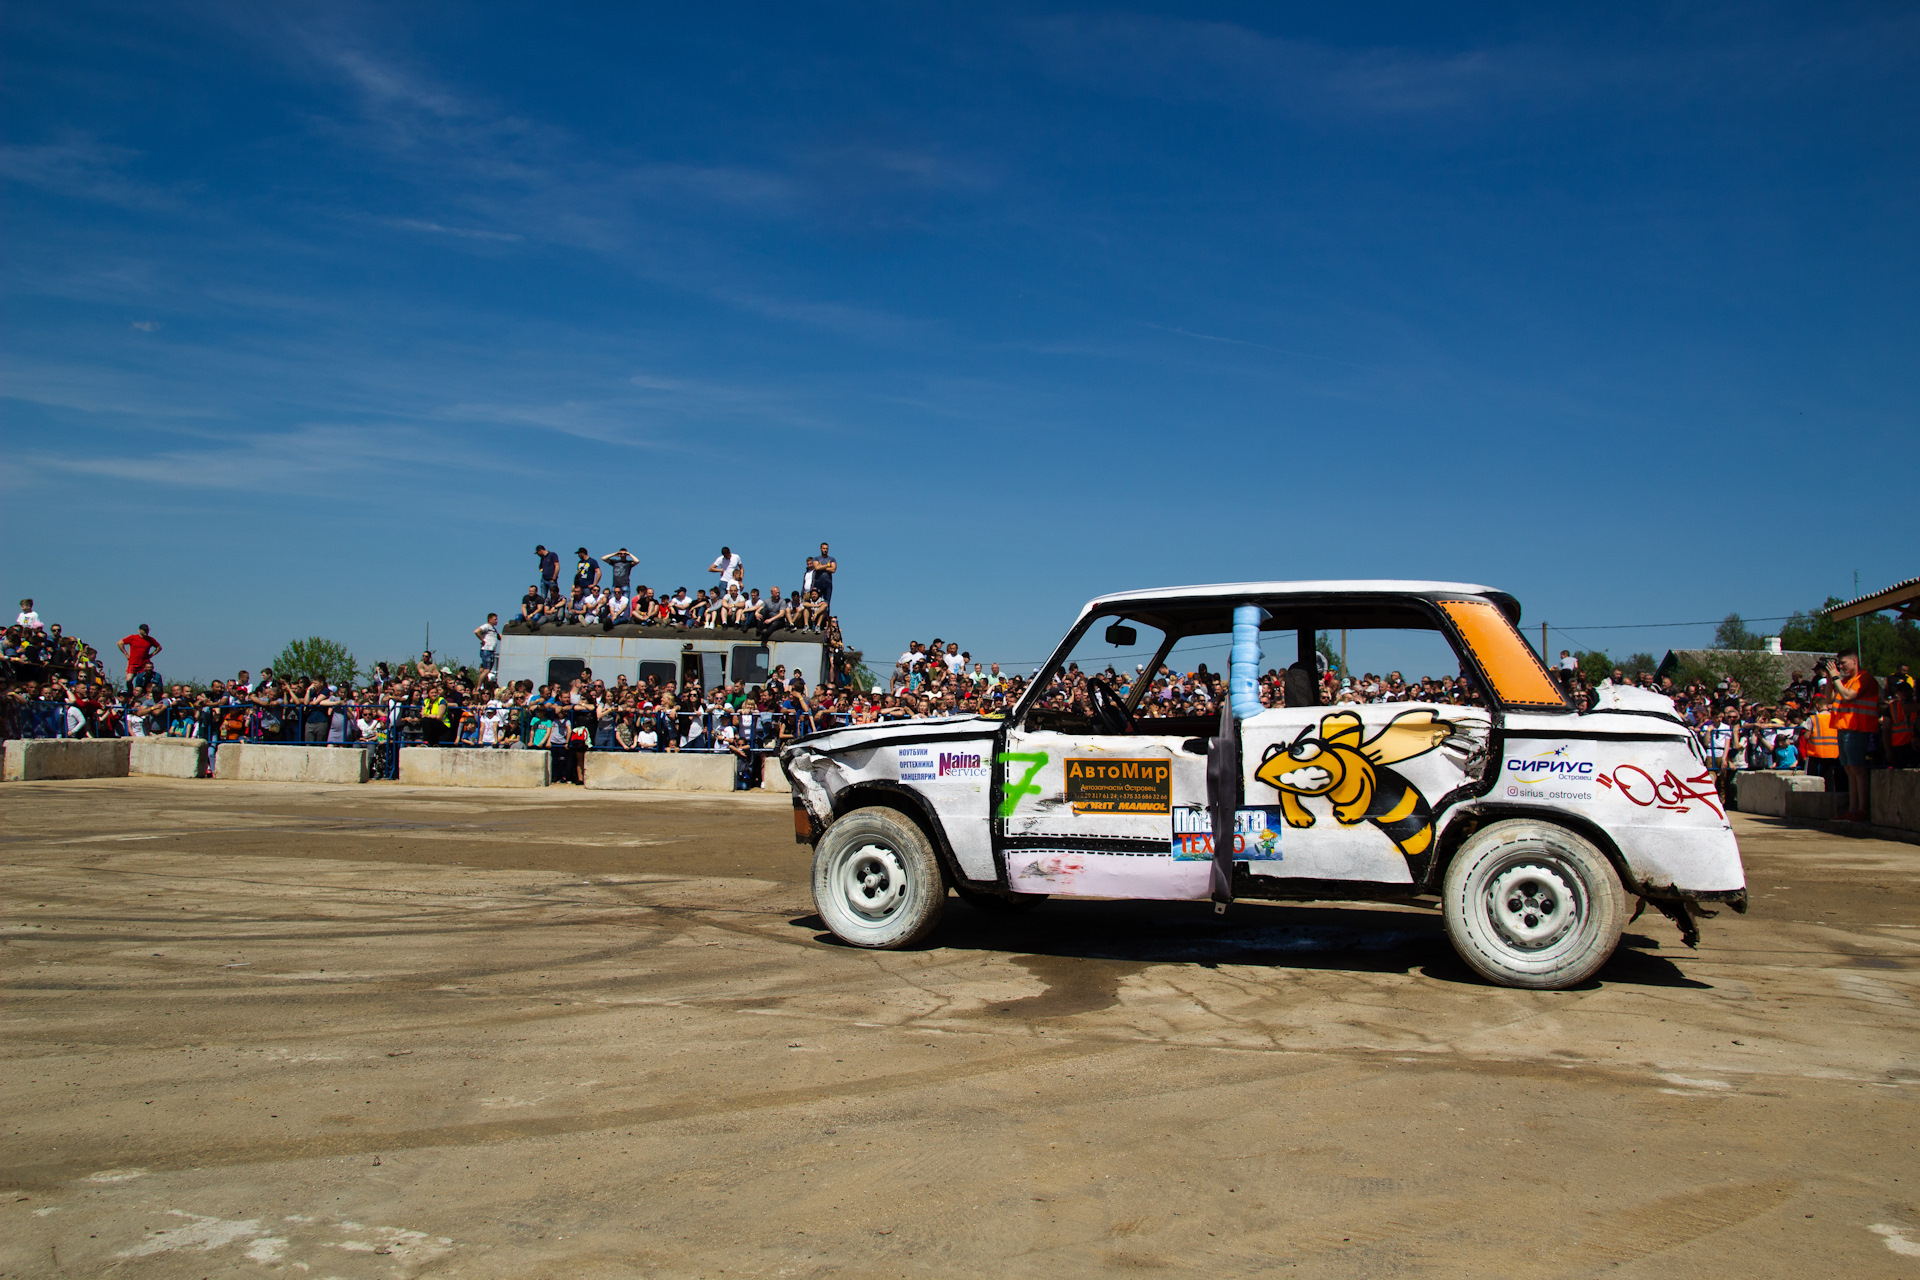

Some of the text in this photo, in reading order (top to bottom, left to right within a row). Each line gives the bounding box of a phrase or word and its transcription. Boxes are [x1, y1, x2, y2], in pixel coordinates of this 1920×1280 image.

[900, 760, 934, 769] ОРГТЕХНИКА
[939, 752, 981, 776] Naina
[1507, 759, 1593, 773] СИРИУС
[901, 773, 936, 781] КАНЦЕЛЯРИЯ
[945, 768, 987, 777] service
[1069, 762, 1169, 783] АвтоМир
[1558, 773, 1592, 782] Островец
[998, 751, 1049, 817] 7
[1125, 784, 1156, 792] Островец
[1519, 788, 1592, 801] sirius_ostrovets
[1118, 802, 1167, 811] MANNOL
[1178, 834, 1246, 854] ТЕХО
